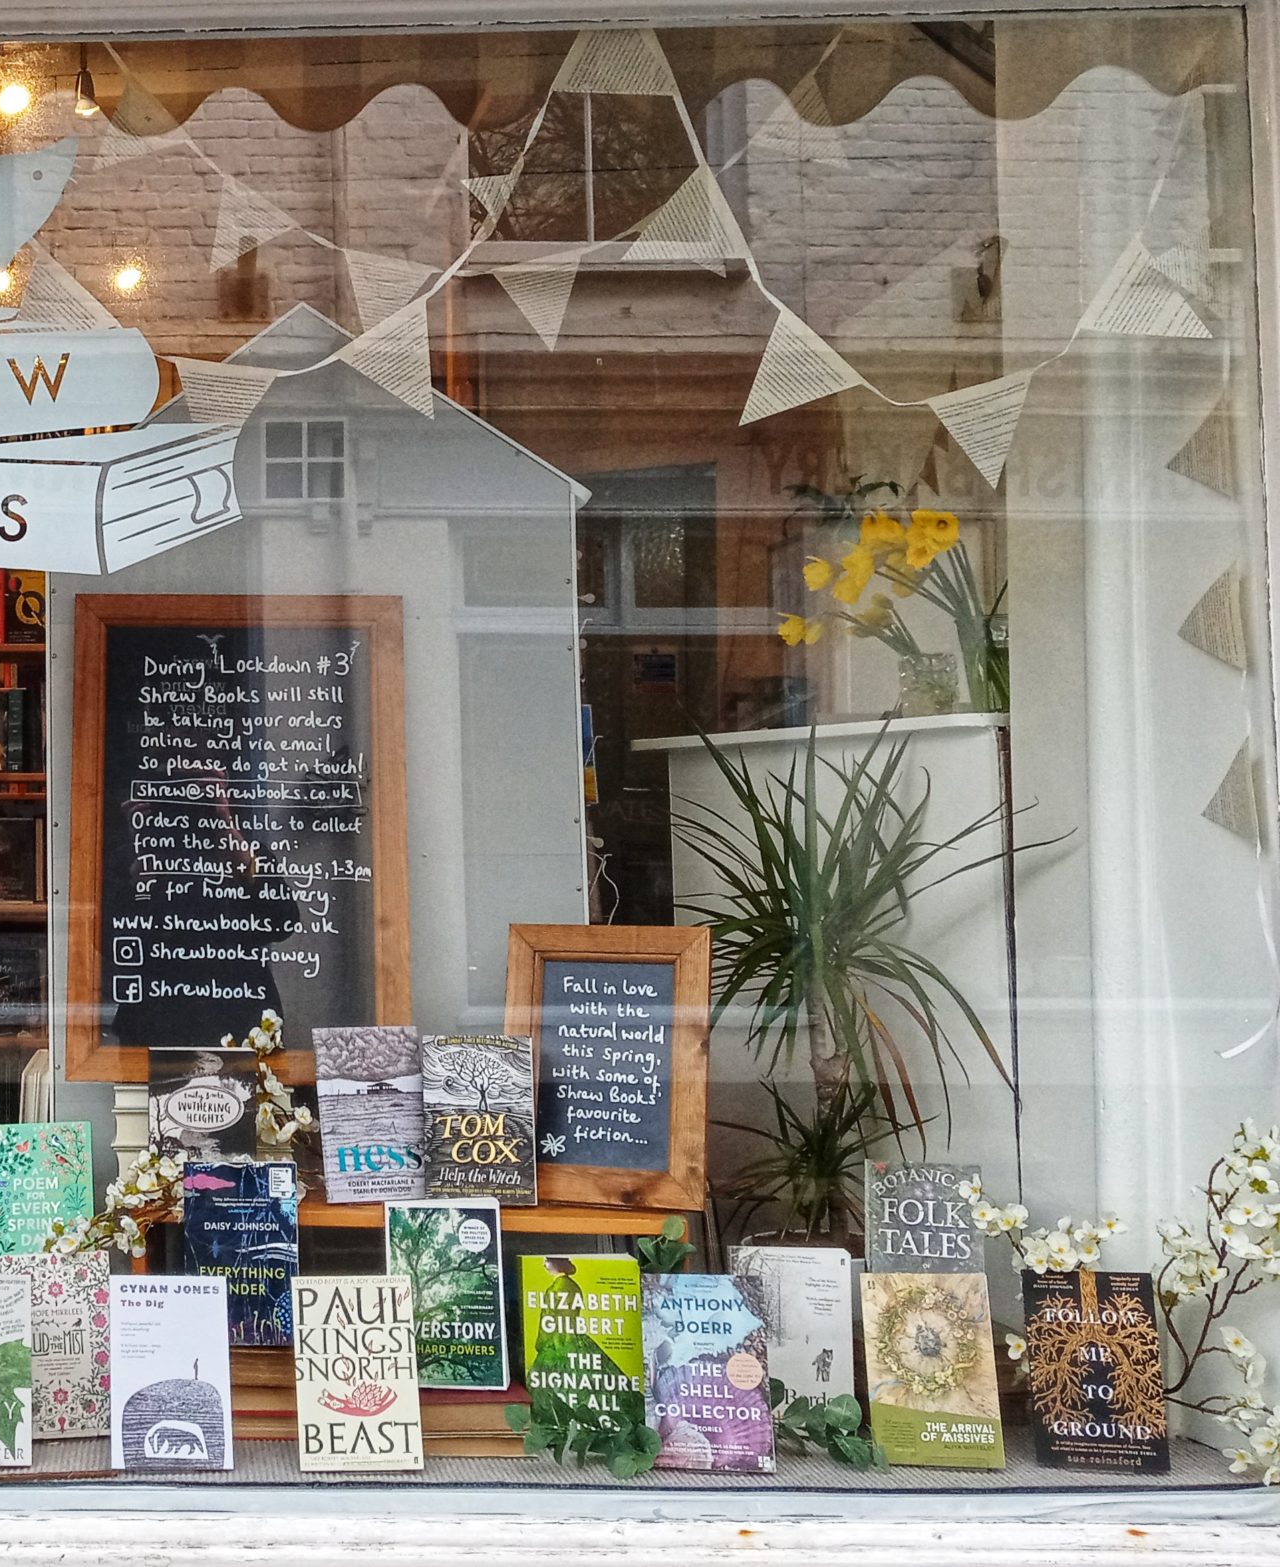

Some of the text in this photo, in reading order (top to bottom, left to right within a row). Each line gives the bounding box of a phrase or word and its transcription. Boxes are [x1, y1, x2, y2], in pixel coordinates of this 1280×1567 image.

[144, 655, 311, 689] During Lockdown
[138, 687, 344, 703] Shrew Books will still
[144, 711, 342, 738] be taking your orders
[140, 733, 336, 757] online and via email,
[138, 752, 363, 781] so please do get in touch!
[131, 812, 362, 834] Orders available to collect
[133, 834, 300, 858] from the shop on:
[137, 853, 234, 884] Thursdays
[166, 881, 336, 915] for home delivery.
[149, 979, 266, 999] Shrewbooks
[563, 976, 658, 997] Fall in love
[570, 1001, 650, 1018] with the
[558, 1022, 664, 1045] natural world
[562, 1043, 594, 1058] this
[552, 1065, 661, 1095] with of
[557, 1084, 603, 1102] Shrew
[178, 1102, 231, 1114] WUTHERING
[566, 1105, 641, 1124] favourite
[186, 1112, 225, 1124] HEIGHTS
[434, 1114, 506, 1139] TOM
[451, 1138, 521, 1165] COX
[13, 1176, 59, 1190] POEM
[348, 1179, 409, 1188] ROBERT MACFARLANE
[440, 1168, 521, 1186] Help the Witch
[871, 1168, 960, 1196] BOTANIC
[11, 1201, 61, 1216] EVERY
[880, 1197, 970, 1229] FOLK
[204, 1221, 280, 1232] DAISY JOHNSON
[878, 1228, 971, 1260] TALES
[199, 1266, 286, 1280] EVERYTHING
[120, 1284, 220, 1295] CYNAN JONES
[120, 1299, 164, 1309] The Dig
[296, 1286, 411, 1326] PAUL
[527, 1291, 638, 1313] ELIZABETH
[660, 1298, 746, 1312] ANTHONY
[31, 1308, 49, 1317] HOPE
[1045, 1308, 1140, 1325] FOLLOW
[414, 1321, 496, 1340] VERSTORY
[541, 1316, 625, 1336] GILBERT
[675, 1321, 733, 1335] DOERR
[450, 1345, 495, 1355] POWERS
[1079, 1347, 1113, 1362] ME
[567, 1352, 602, 1371] THE
[690, 1363, 722, 1378] THE
[530, 1372, 641, 1392] SIGNATURE
[679, 1383, 734, 1399] SHELL
[1082, 1384, 1114, 1400] TO
[587, 1393, 620, 1412] ALL
[655, 1403, 762, 1421] COLLECTOR
[694, 1425, 723, 1433] STORIES
[925, 1421, 995, 1434] THE ARRIVAL
[1053, 1420, 1152, 1441] GROUND
[303, 1421, 419, 1455] BEAST
[920, 1432, 995, 1444] OF MISSIVES
